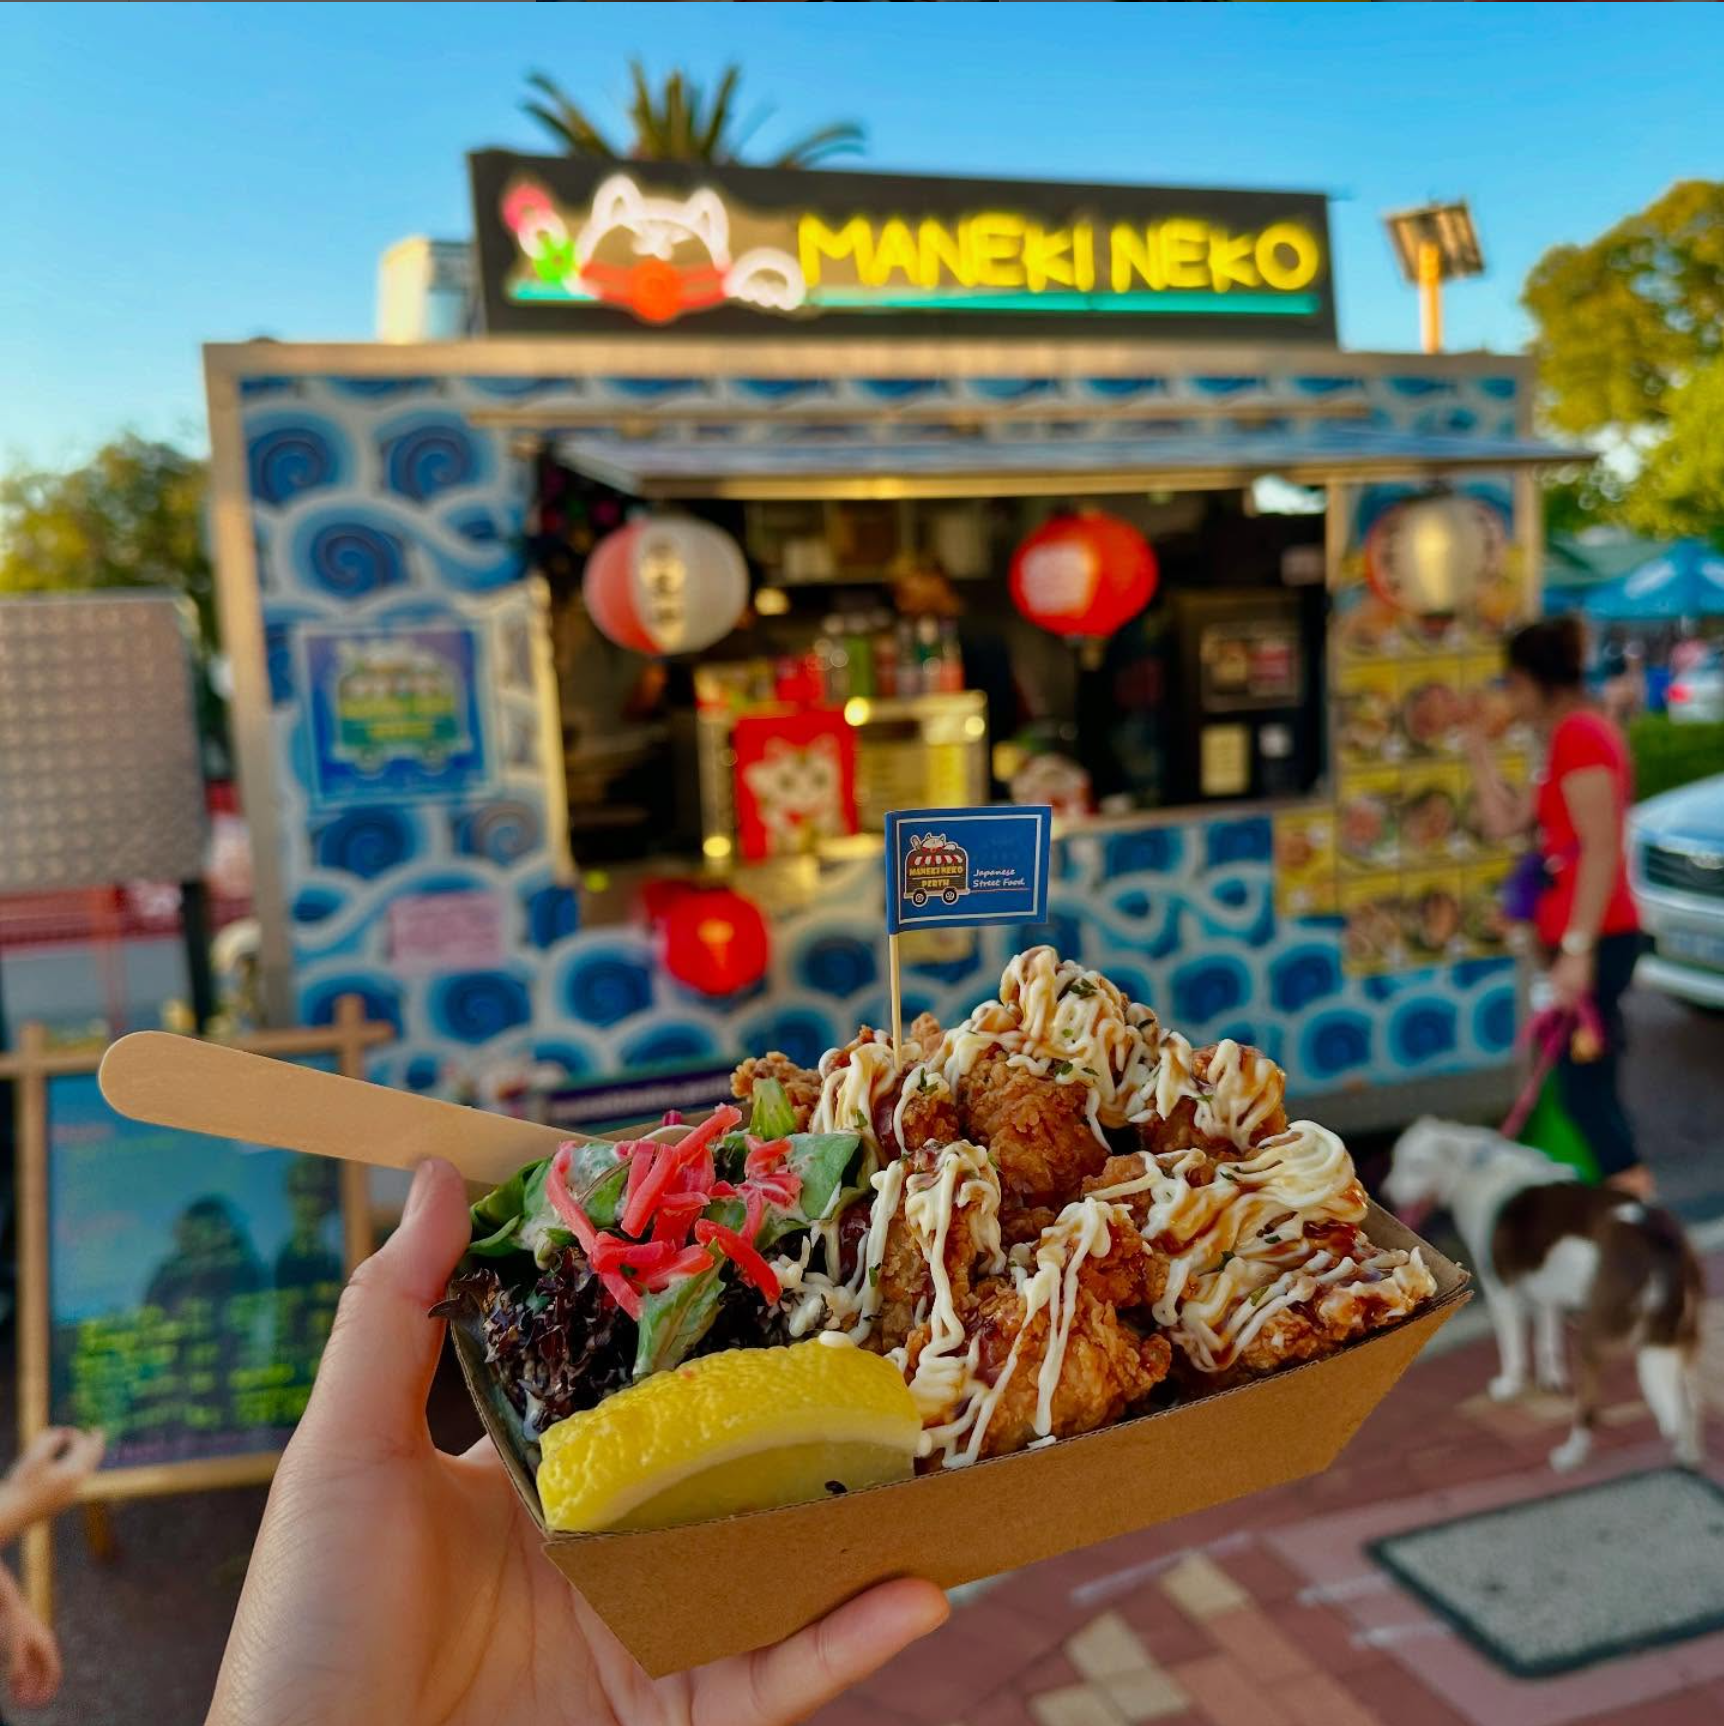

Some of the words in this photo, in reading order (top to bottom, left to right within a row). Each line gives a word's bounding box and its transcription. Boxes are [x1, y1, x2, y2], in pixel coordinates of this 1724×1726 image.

[799, 211, 1095, 294] MANEKI
[1108, 217, 1322, 295] NEKO
[972, 868, 1016, 878] Japanese
[921, 879, 950, 888] PERTH
[972, 879, 1001, 888] Street
[1002, 877, 1026, 887] Food
